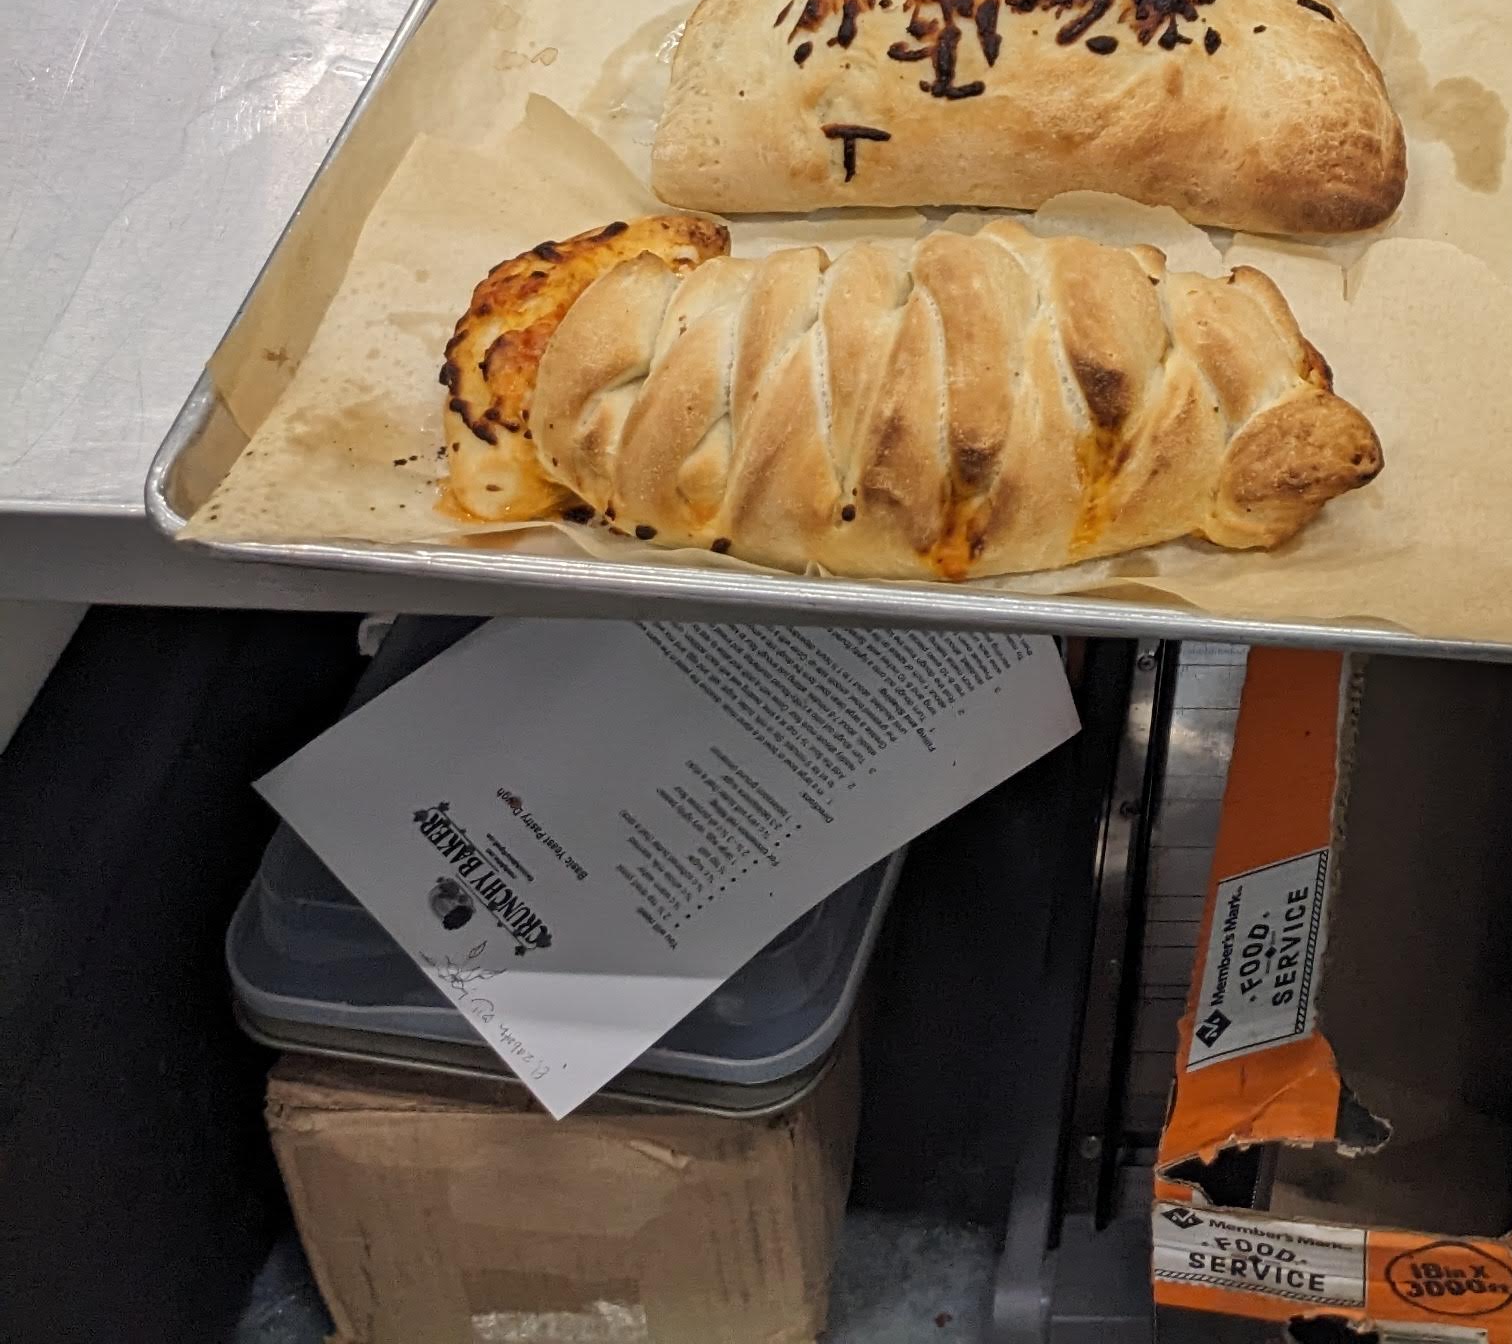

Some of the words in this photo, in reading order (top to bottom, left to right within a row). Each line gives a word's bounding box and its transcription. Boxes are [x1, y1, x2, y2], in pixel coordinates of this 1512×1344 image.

[419, 810, 482, 876] BAKER
[520, 812, 546, 840] Pastry
[542, 835, 566, 860] Yeast
[564, 856, 588, 880] Basic
[470, 864, 547, 944] CRUNCHY
[1239, 923, 1270, 996] FOOD
[1271, 885, 1310, 1007] SERVICE
[1210, 932, 1236, 1007] Member's
[1208, 1218, 1295, 1243] Member's
[1214, 1236, 1297, 1265] FOOD
[1187, 1252, 1327, 1293] SERVICE
